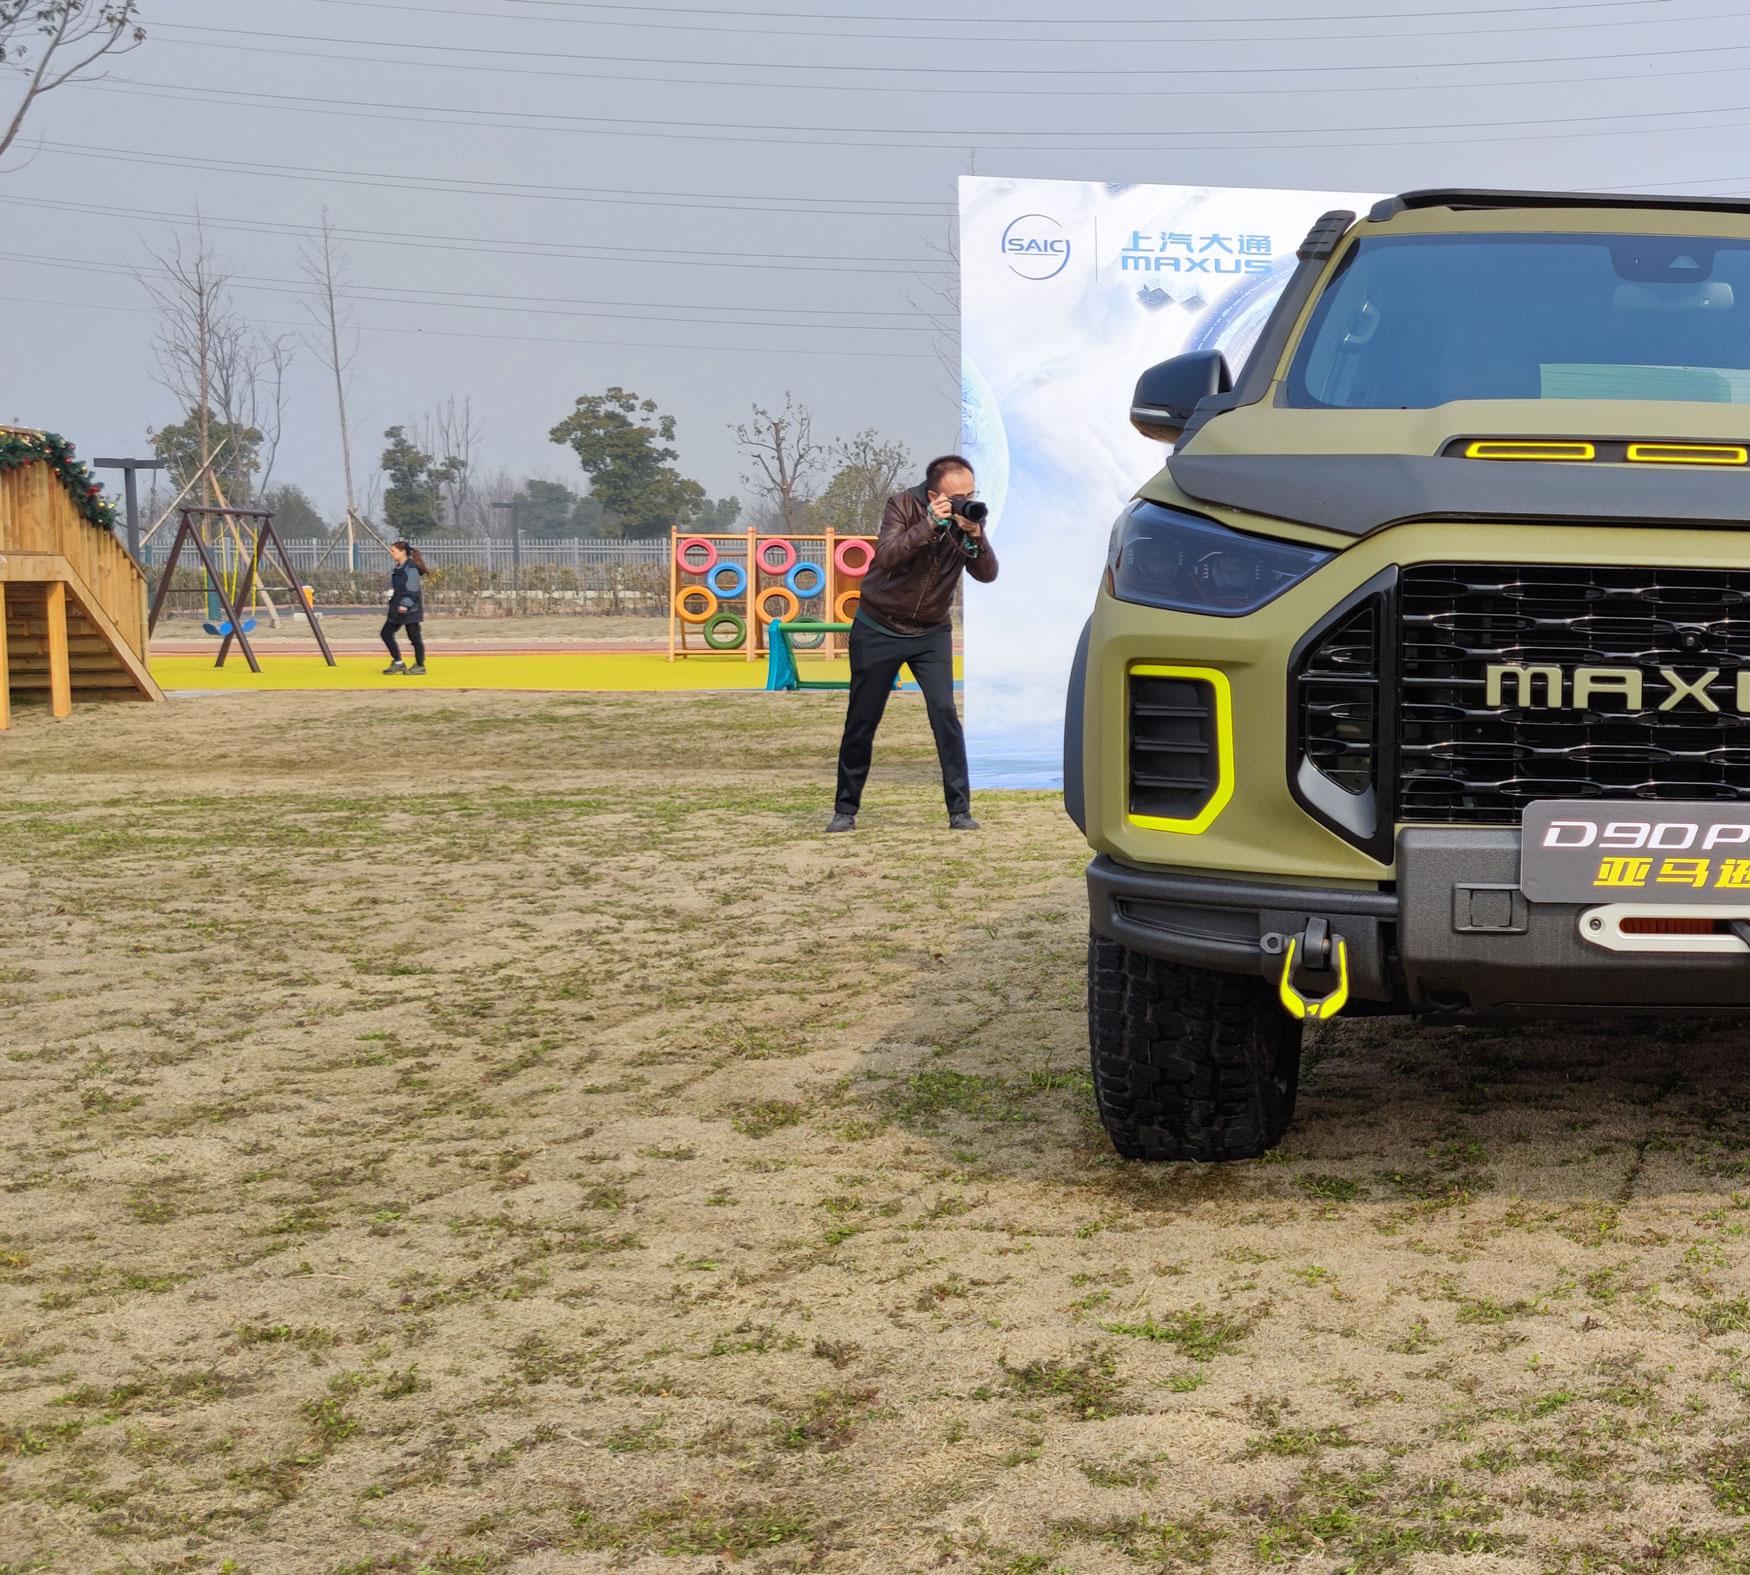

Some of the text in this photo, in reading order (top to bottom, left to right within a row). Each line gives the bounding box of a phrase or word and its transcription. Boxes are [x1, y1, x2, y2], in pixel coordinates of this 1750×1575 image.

[1007, 238, 1065, 253] SAIC
[1121, 230, 1272, 256] 上汽大通
[1121, 255, 1272, 275] MAXUS
